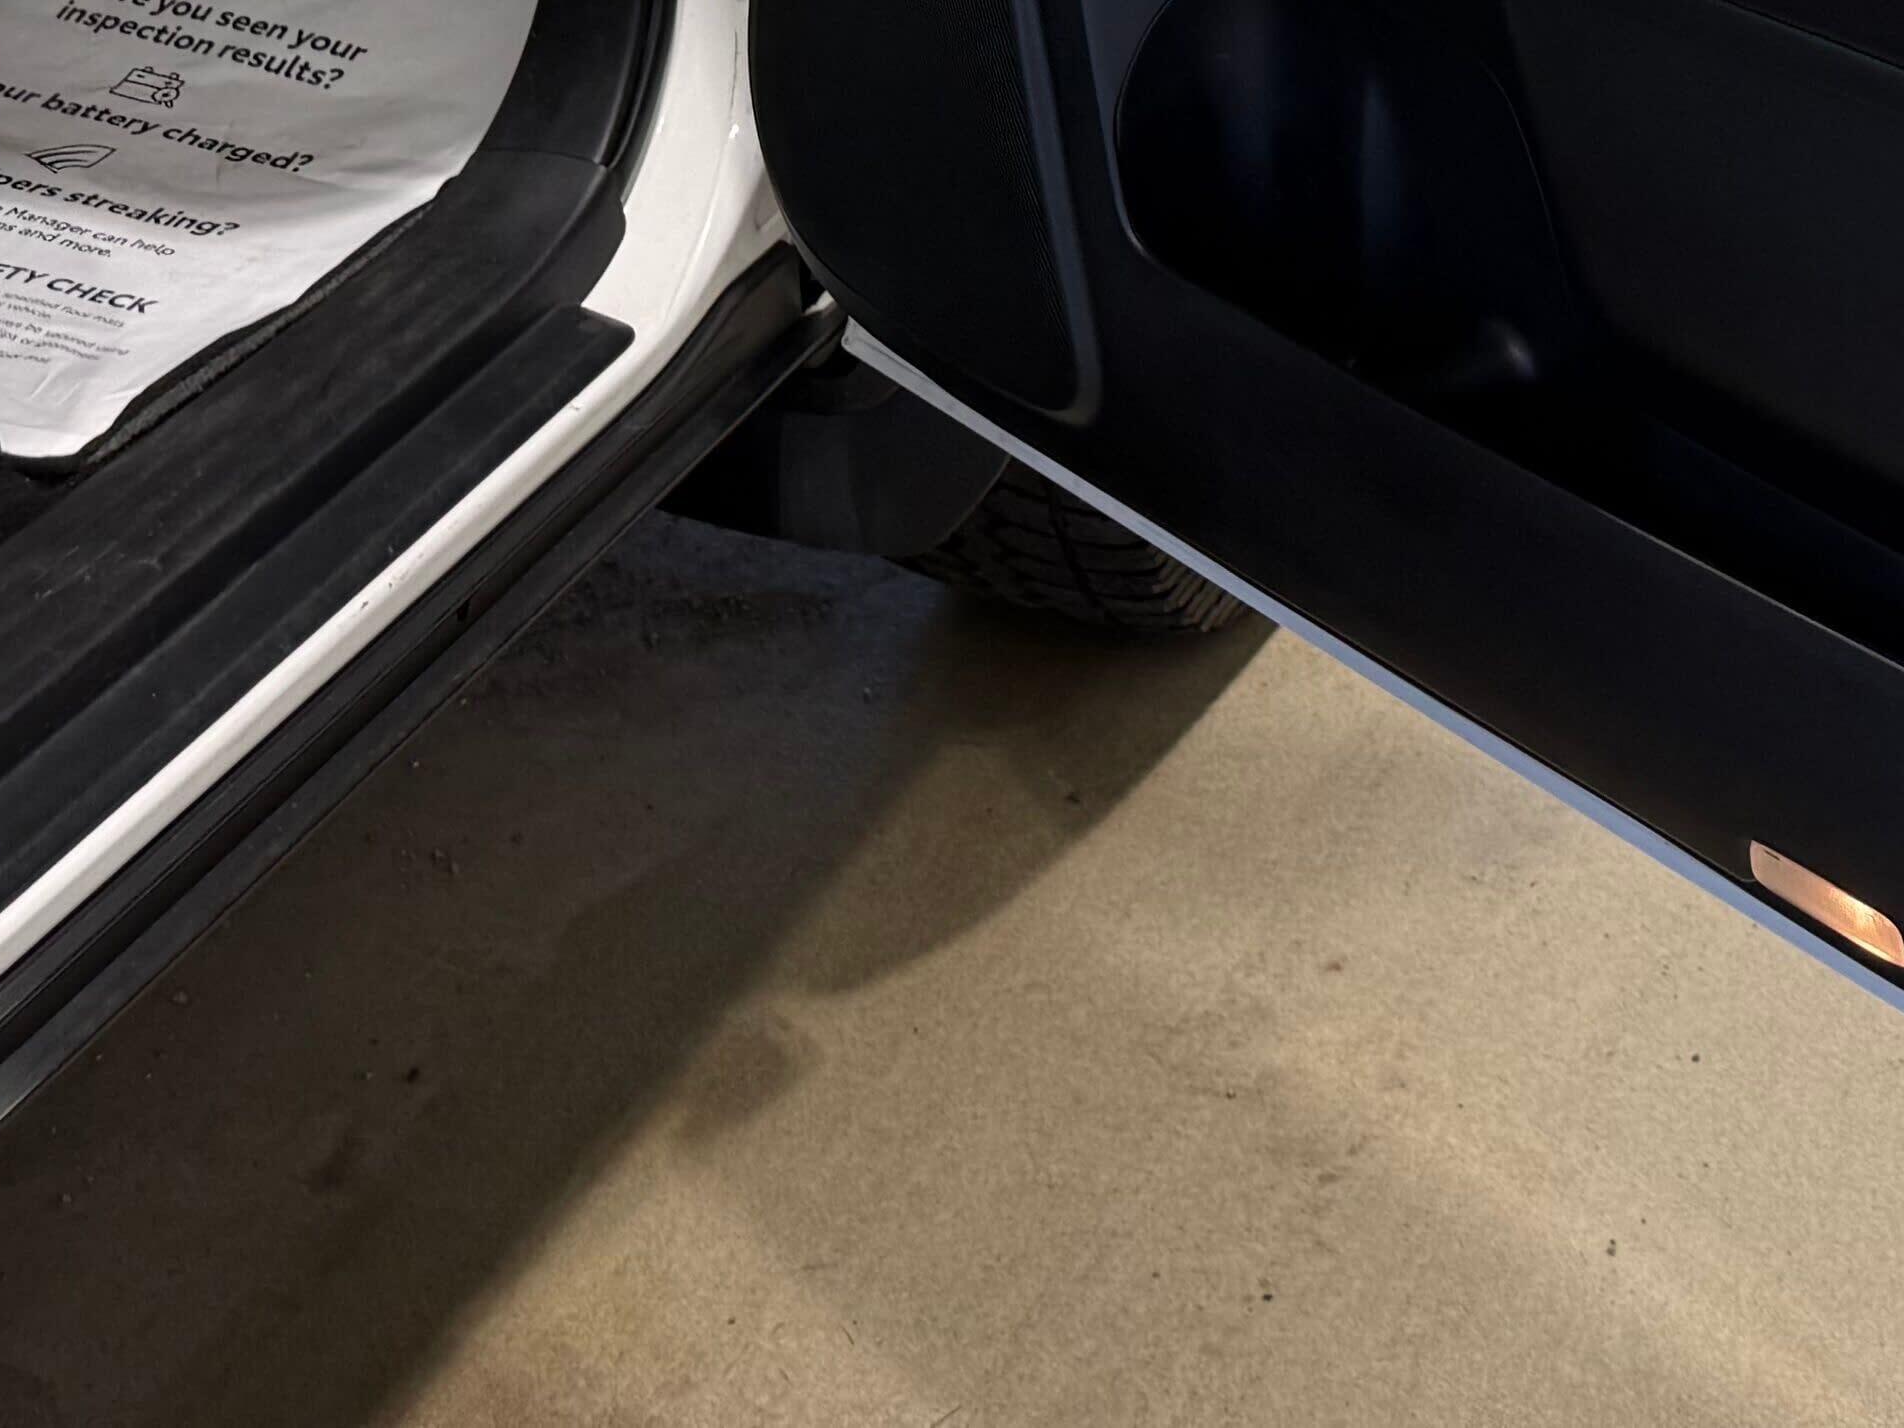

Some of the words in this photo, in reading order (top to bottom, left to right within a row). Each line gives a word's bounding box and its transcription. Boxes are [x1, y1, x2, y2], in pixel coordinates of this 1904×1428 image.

[56, 0, 215, 57] inspection
[218, 43, 345, 90] results?
[216, 10, 288, 40] seen
[287, 27, 368, 62] your
[41, 92, 160, 135] battery
[163, 125, 313, 173] charged?
[5, 206, 92, 238] Manager
[92, 231, 129, 247] can
[130, 238, 176, 258] help
[64, 191, 240, 237] streaking?
[18, 227, 60, 243] and
[60, 238, 113, 258] more.
[47, 277, 159, 314] CHECK
